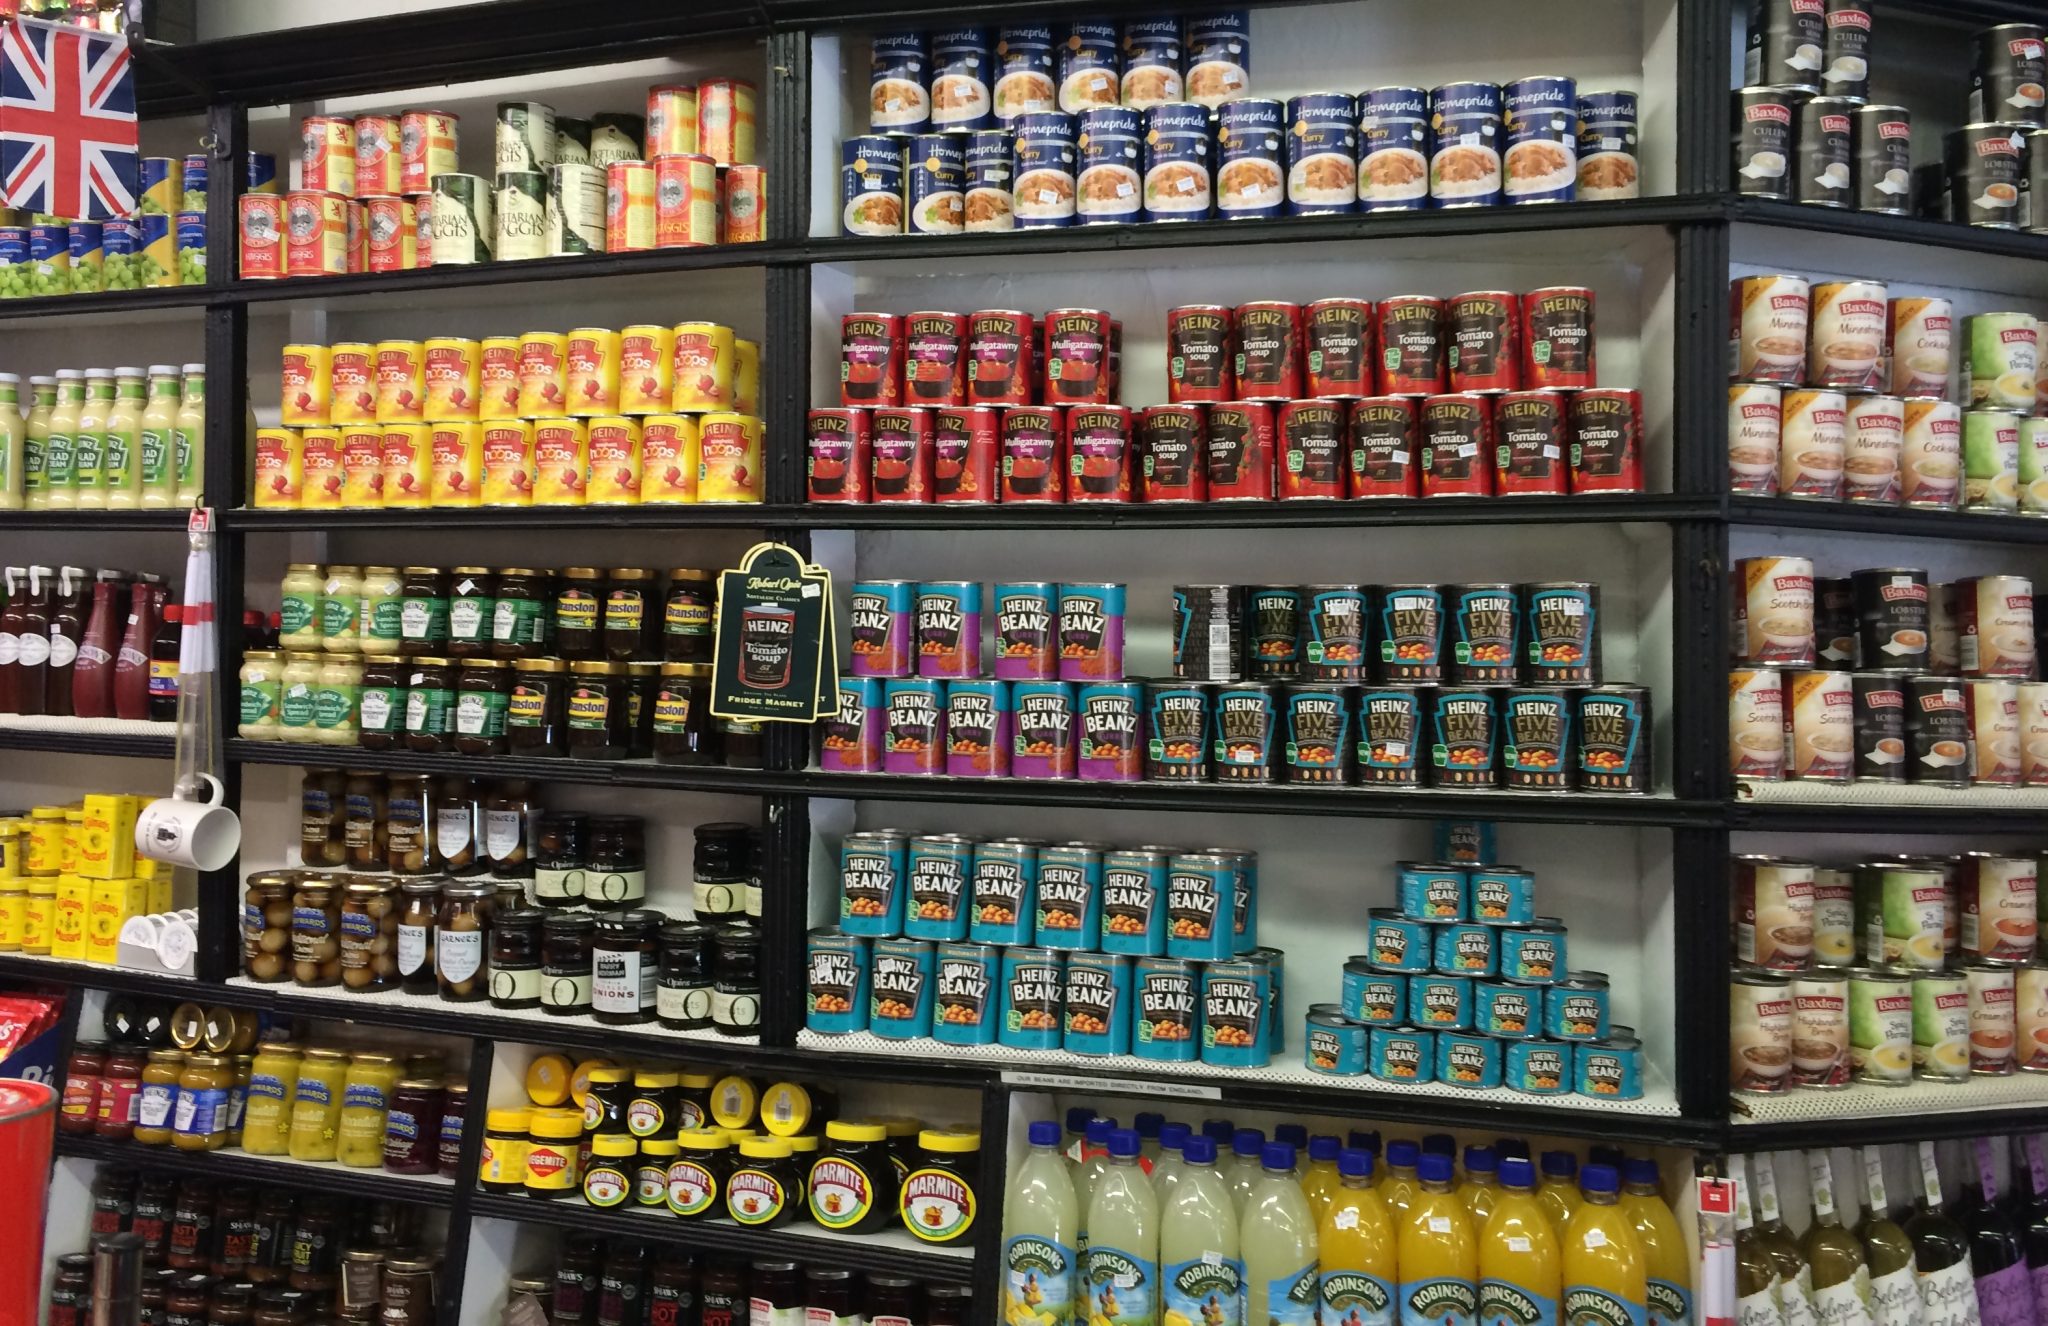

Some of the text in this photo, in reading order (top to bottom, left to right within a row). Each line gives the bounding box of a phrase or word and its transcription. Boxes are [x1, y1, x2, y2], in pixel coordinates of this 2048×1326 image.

[1433, 94, 1494, 110] Homepride
[1504, 88, 1565, 106] Homepride
[1296, 103, 1354, 119] Homepride
[1363, 100, 1423, 115] Homepride
[1577, 104, 1634, 118] Homepride
[1080, 116, 1136, 132] Homepride
[1148, 113, 1206, 130] Homepride
[1220, 110, 1278, 127] Homepride
[1017, 121, 1073, 138] Homepride
[1316, 309, 1359, 324] HEINZ
[1453, 303, 1496, 318] HEINZ
[1178, 317, 1220, 331] HEINZ
[1241, 312, 1282, 326] HEINZ
[845, 321, 884, 337] HEINZ
[913, 321, 954, 335] HEINZ
[1056, 319, 1097, 334] HEINZ
[1548, 327, 1587, 337] Tomato
[1319, 337, 1358, 347] Tomato
[1456, 331, 1494, 341] Tomato
[1558, 336, 1578, 345] soup
[1052, 340, 1103, 352] Mulligatawny
[1181, 344, 1218, 354] Tomato
[1243, 339, 1278, 350] Tomato
[1328, 345, 1349, 355] soup
[1463, 339, 1483, 349] soup
[1189, 353, 1210, 362] soup
[1504, 403, 1549, 418] HEINZ
[1576, 400, 1620, 416] HEINZ
[1078, 415, 1119, 430] HEINZ
[1149, 415, 1189, 430] HEINZ
[1359, 409, 1402, 423] HEINZ
[1362, 436, 1400, 447] Tomato
[1507, 432, 1547, 442] Tomato
[1579, 429, 1618, 440] Tomato
[1073, 436, 1125, 448] Mulligatawny
[1151, 442, 1187, 452] Tomato
[1587, 438, 1608, 448] soup
[536, 449, 572, 461] hoops
[590, 447, 626, 460] hoops
[704, 444, 743, 457] hoops
[404, 601, 424, 610] HEINZ
[455, 601, 476, 610] HEINZ
[1006, 600, 1042, 614] HEINZ
[1470, 598, 1510, 612] HEINZ
[1001, 613, 1048, 632] BEANZ
[1470, 612, 1510, 626] FIVE
[748, 621, 789, 633] HEINZ
[1471, 625, 1510, 637] BEANZ
[745, 642, 788, 654] Tomato
[752, 654, 781, 663] soup
[728, 696, 804, 707] FRIDGE MAGNET
[895, 696, 930, 709] HEINZ
[1026, 698, 1063, 711] HEINZ
[1092, 699, 1130, 714] HEINZ
[1225, 699, 1263, 713] HEINZ
[1370, 700, 1409, 714] HEINZ
[1447, 701, 1486, 715] HEINZ
[1517, 702, 1556, 716] HEINZ
[890, 711, 938, 728] BEANZ
[1020, 713, 1070, 731] BEANZ
[1087, 715, 1136, 733] BEANZ
[1225, 713, 1263, 728] FIVE
[1370, 715, 1408, 729] FIVE
[1447, 715, 1486, 730] FIVE
[1516, 717, 1556, 732] FIVE
[1227, 724, 1264, 737] BEANZ
[1371, 726, 1409, 740] BEANZ
[1447, 728, 1487, 741] BEANZ
[1517, 730, 1558, 744] BEANZ
[849, 857, 884, 873] HEINZ
[920, 861, 956, 877] HEINZ
[845, 873, 890, 890] BEANZ
[1044, 869, 1080, 886] HEINZ
[1108, 872, 1144, 888] HEINZ
[913, 876, 962, 895] BEANZ
[1433, 880, 1454, 891] HEINZ
[1040, 884, 1087, 902] BEANZ
[1104, 888, 1151, 908] BEANZ
[1428, 890, 1459, 901] BEANZ
[1020, 968, 1058, 984] HEINZ
[1151, 976, 1189, 992] HEINZ
[1213, 982, 1251, 999] HEINZ
[1014, 983, 1062, 1002] BEANZ
[1430, 986, 1453, 997] HEINZ
[1144, 993, 1194, 1012] BEANZ
[1207, 998, 1259, 1018] BEANZ
[1426, 995, 1458, 1007] BEANZ
[1570, 998, 1594, 1009] HEINZ
[1797, 999, 1843, 1009] Baxters
[1565, 1008, 1599, 1019] BEANZ
[1592, 1056, 1616, 1067] HEINZ
[1588, 1066, 1621, 1079] BEANZ
[529, 1155, 565, 1167] EGEMITE
[589, 1172, 624, 1186] MARMITE
[668, 1164, 709, 1182] MARMITE
[814, 1165, 862, 1189] MARMITE
[733, 1174, 775, 1191] MARMITE
[909, 1176, 966, 1202] MARMITE
[1009, 1241, 1064, 1270] ROBINSONS
[1324, 1273, 1386, 1305] ROBINSONS
[1413, 1284, 1476, 1308] ROBINSONS
